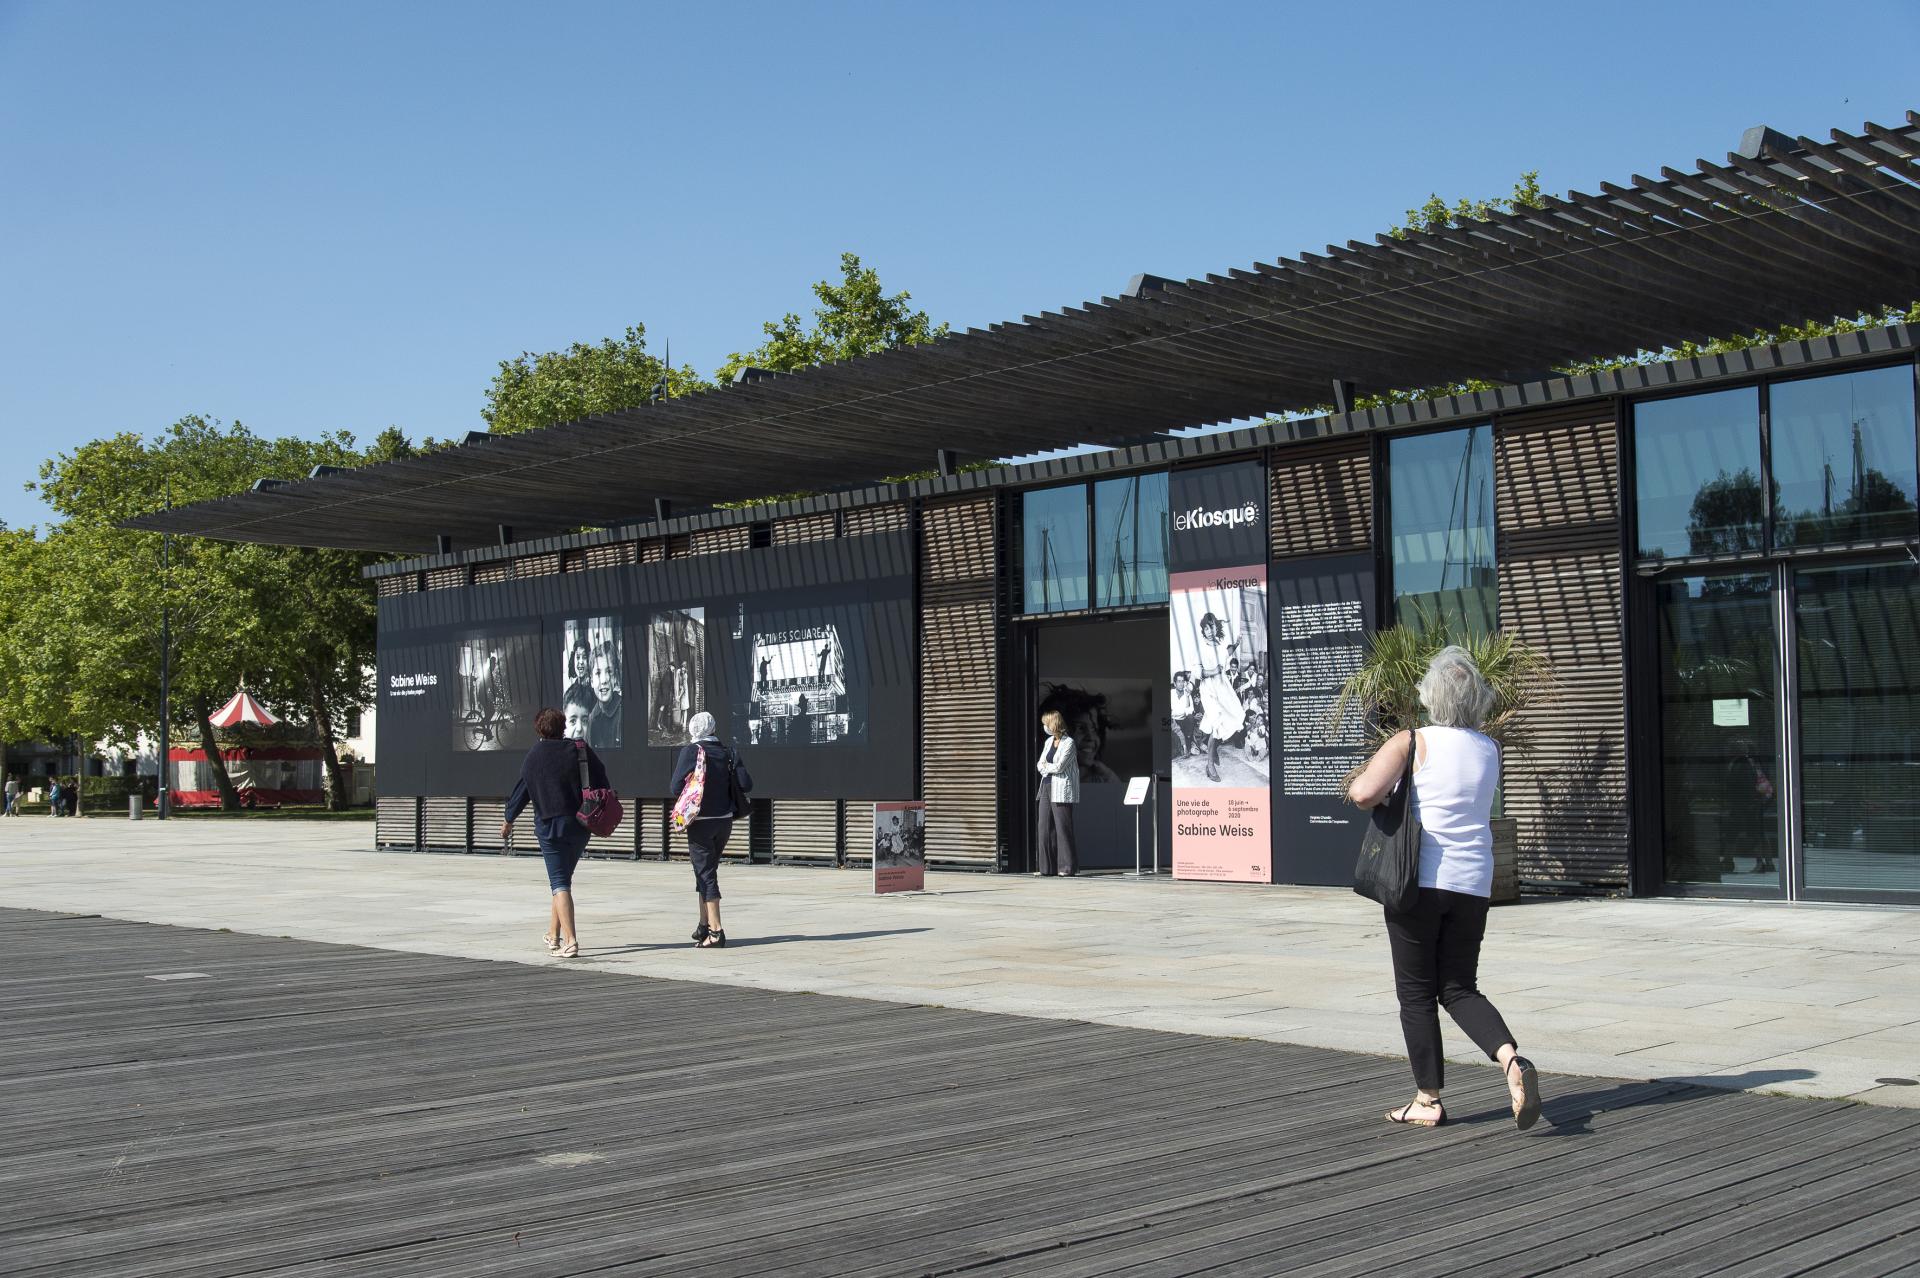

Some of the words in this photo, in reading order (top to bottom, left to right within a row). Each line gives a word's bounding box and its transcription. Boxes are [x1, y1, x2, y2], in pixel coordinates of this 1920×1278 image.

[790, 627, 821, 642] SQUARE
[391, 674, 414, 688] Sabine
[415, 672, 437, 686] Weiss
[1235, 799, 1244, 807] juin
[1177, 808, 1219, 817] photographe
[1177, 823, 1217, 836] Sabine
[1219, 824, 1254, 837] Weiss
